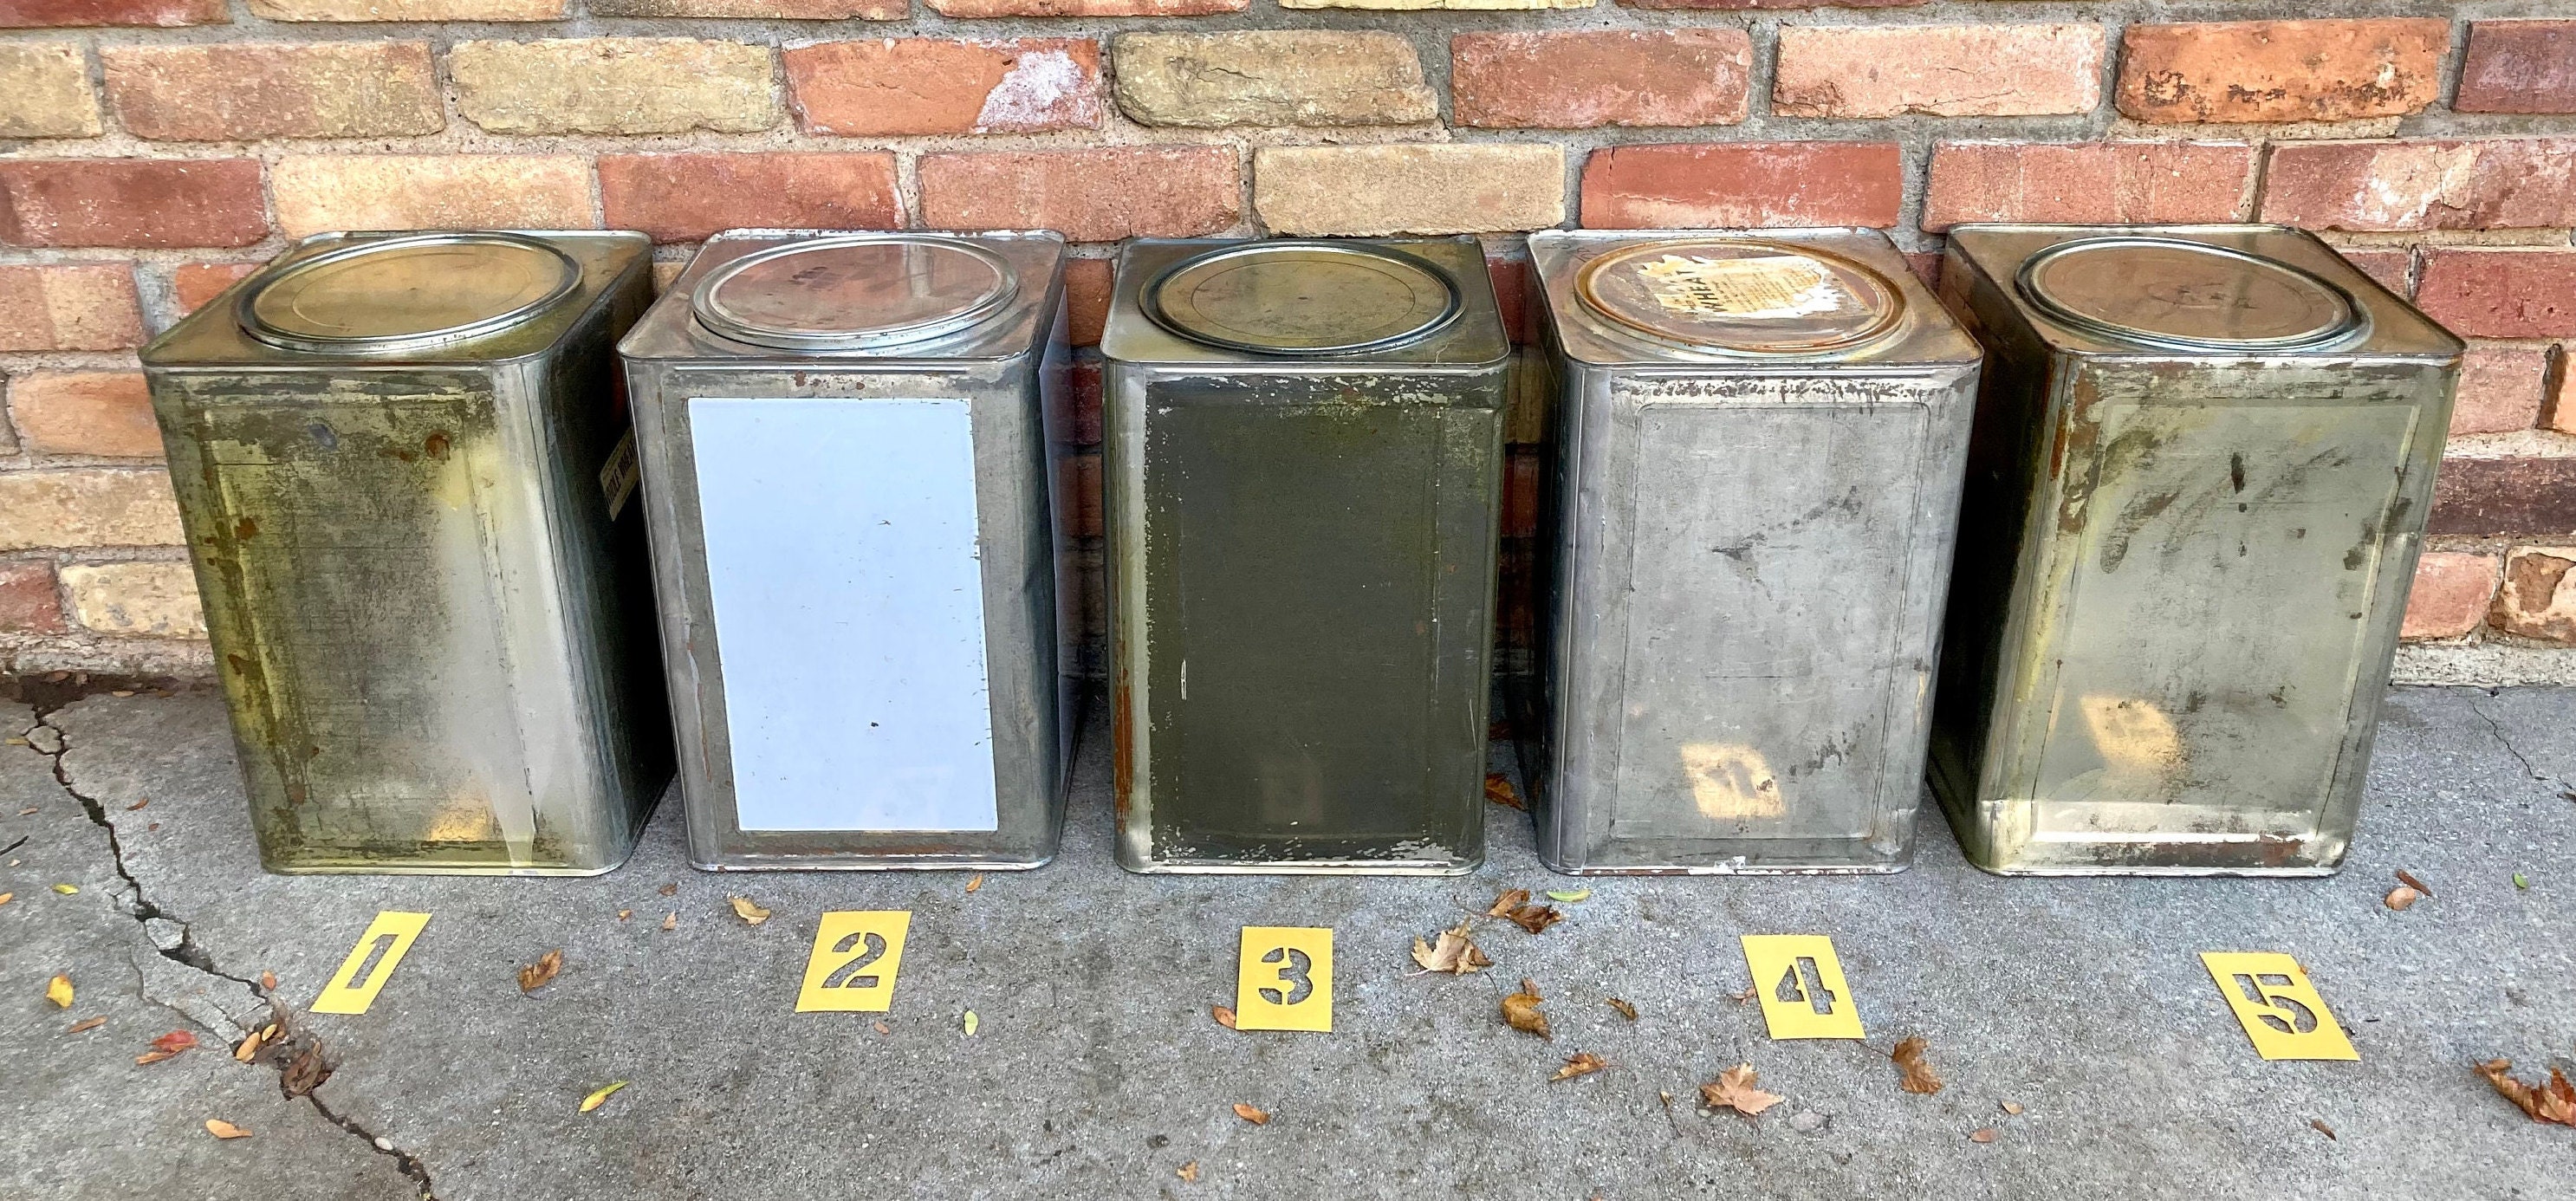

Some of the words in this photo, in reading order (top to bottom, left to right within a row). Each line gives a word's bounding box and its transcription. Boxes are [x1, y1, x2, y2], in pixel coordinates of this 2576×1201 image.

[1675, 270, 1729, 313] WHEAT
[346, 933, 399, 989] 1
[821, 932, 887, 989] 2
[1258, 947, 1314, 1005] 3
[1775, 957, 1837, 1015] 4
[2231, 973, 2318, 1035] 5
